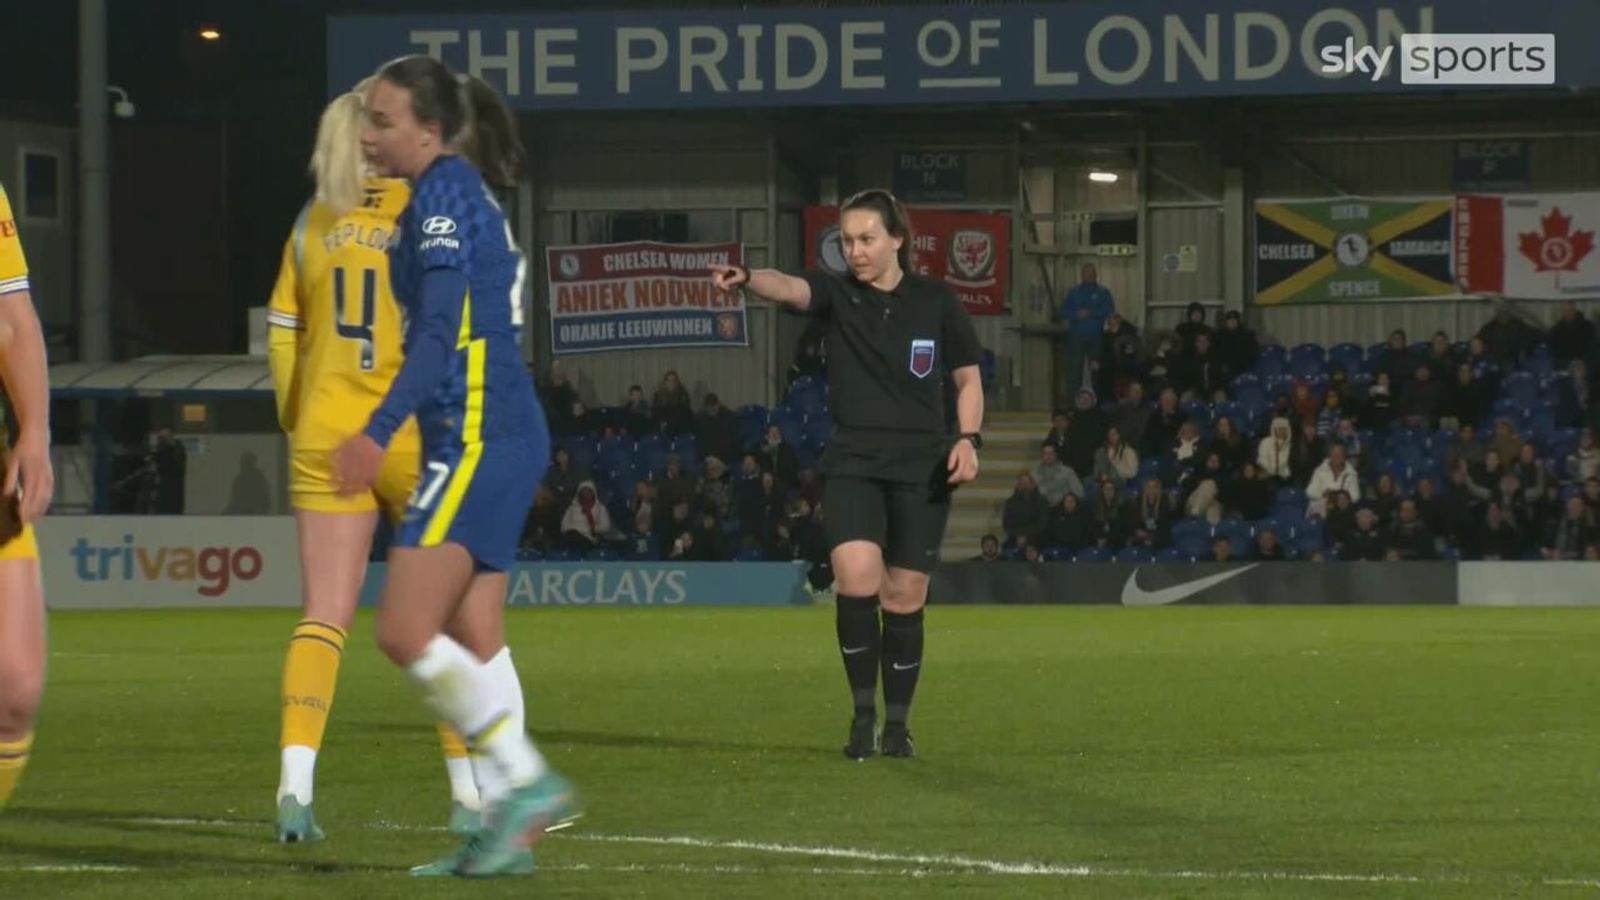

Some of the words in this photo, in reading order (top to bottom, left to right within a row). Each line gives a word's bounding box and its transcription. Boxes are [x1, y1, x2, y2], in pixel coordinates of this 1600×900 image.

[409, 29, 580, 96] THE
[616, 21, 886, 95] PRIDE
[916, 20, 1001, 67] OF
[1033, 6, 1434, 87] LONDON
[901, 153, 960, 169] BLOCK
[911, 235, 938, 251] HIE
[1259, 244, 1315, 260] CHELSEA
[603, 250, 667, 272] CHELSEA
[669, 252, 729, 270] WOMEN
[556, 281, 629, 314] ANIEK
[957, 292, 992, 305] ALES
[1328, 280, 1381, 297] SPENCE
[333, 266, 377, 372] 4
[560, 320, 615, 343] ORANJE
[618, 318, 713, 340] LEEUWINNEN
[70, 534, 263, 597] trivago
[508, 570, 687, 604] ARCLAYS
